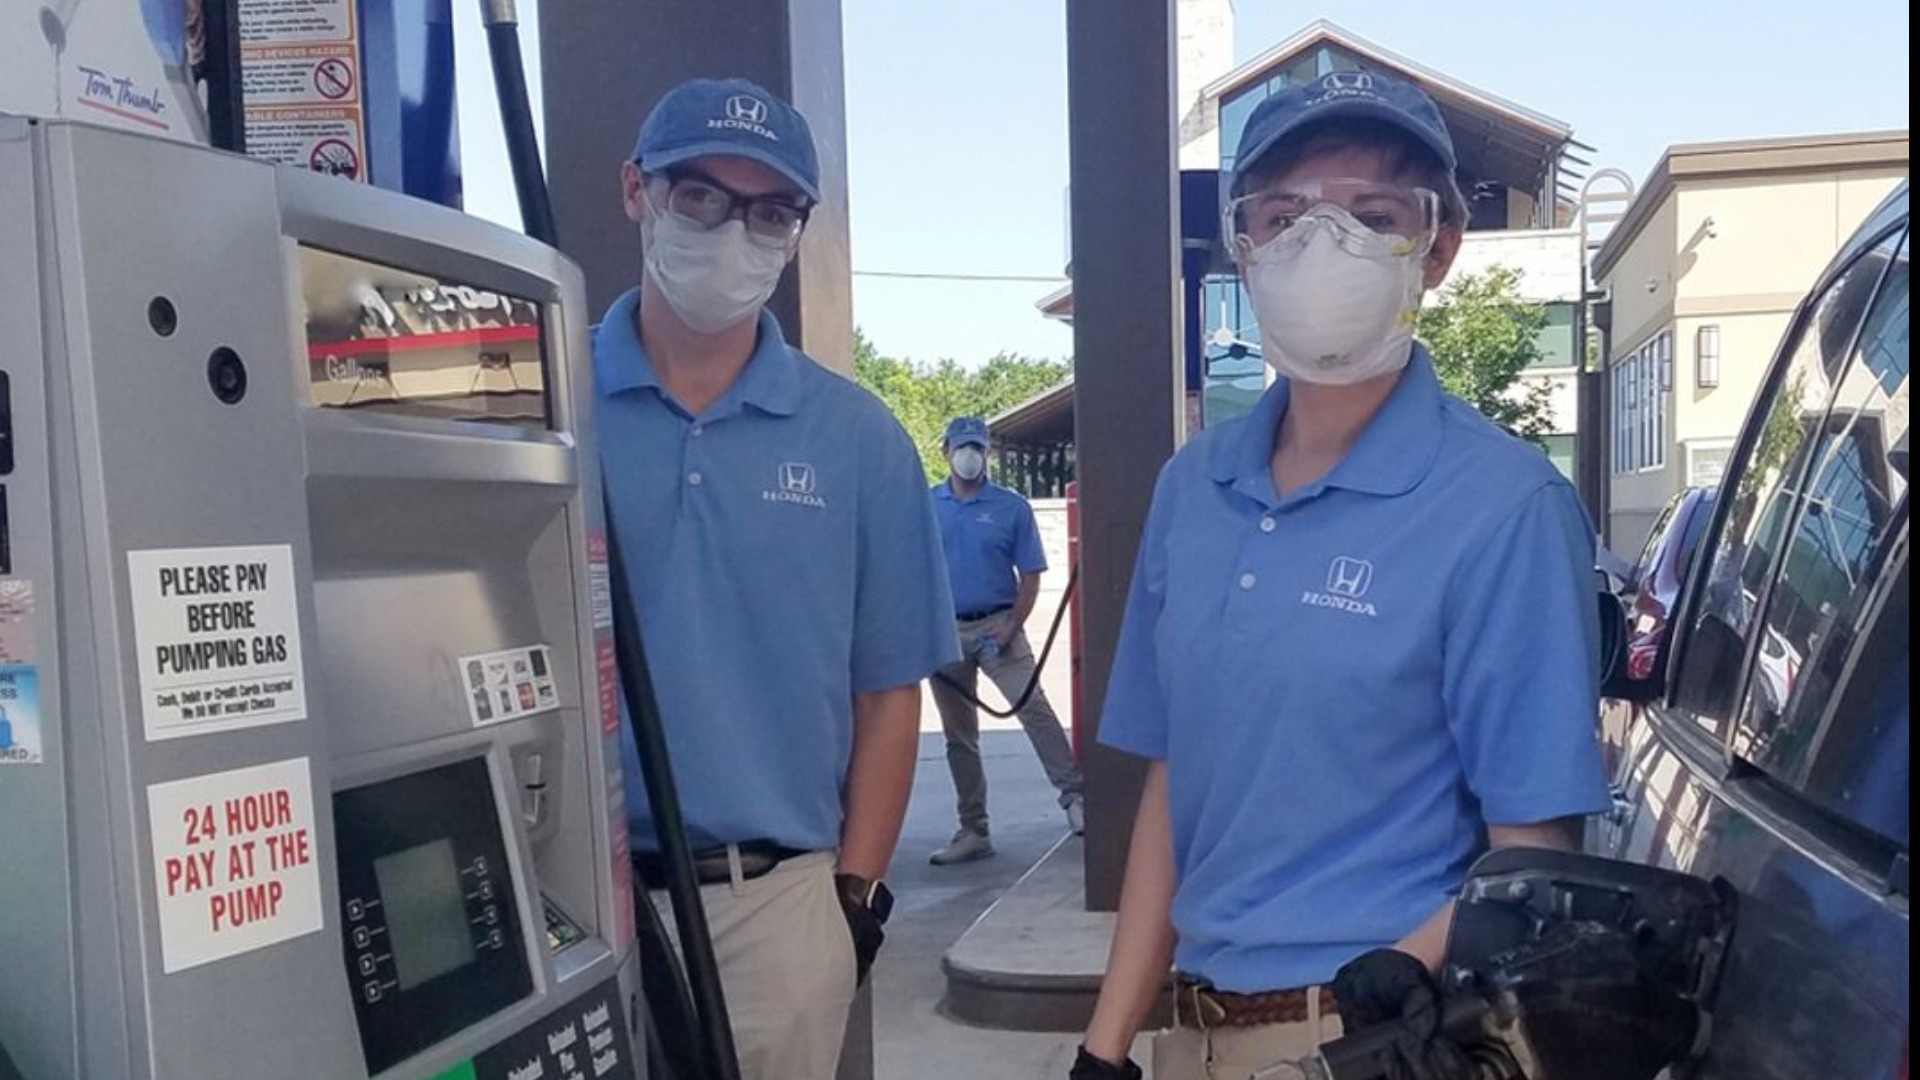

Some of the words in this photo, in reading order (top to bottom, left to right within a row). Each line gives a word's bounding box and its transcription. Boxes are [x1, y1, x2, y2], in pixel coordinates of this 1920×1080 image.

[77, 66, 114, 100] Tom
[112, 77, 165, 114] Thumb
[707, 119, 779, 141] HONDA
[762, 490, 826, 508] HONDA
[160, 565, 232, 596] PLEASE
[236, 563, 267, 592] PAY
[187, 601, 255, 633] BEFORE
[1302, 591, 1377, 616] HONDA
[156, 638, 247, 675] PUMPING
[252, 635, 287, 665] GAS
[184, 805, 216, 846] 24
[226, 790, 291, 837] HOUR
[166, 850, 215, 896] PAY
[229, 841, 255, 882] AT
[265, 829, 310, 871] THE
[211, 881, 283, 932] PUMP
